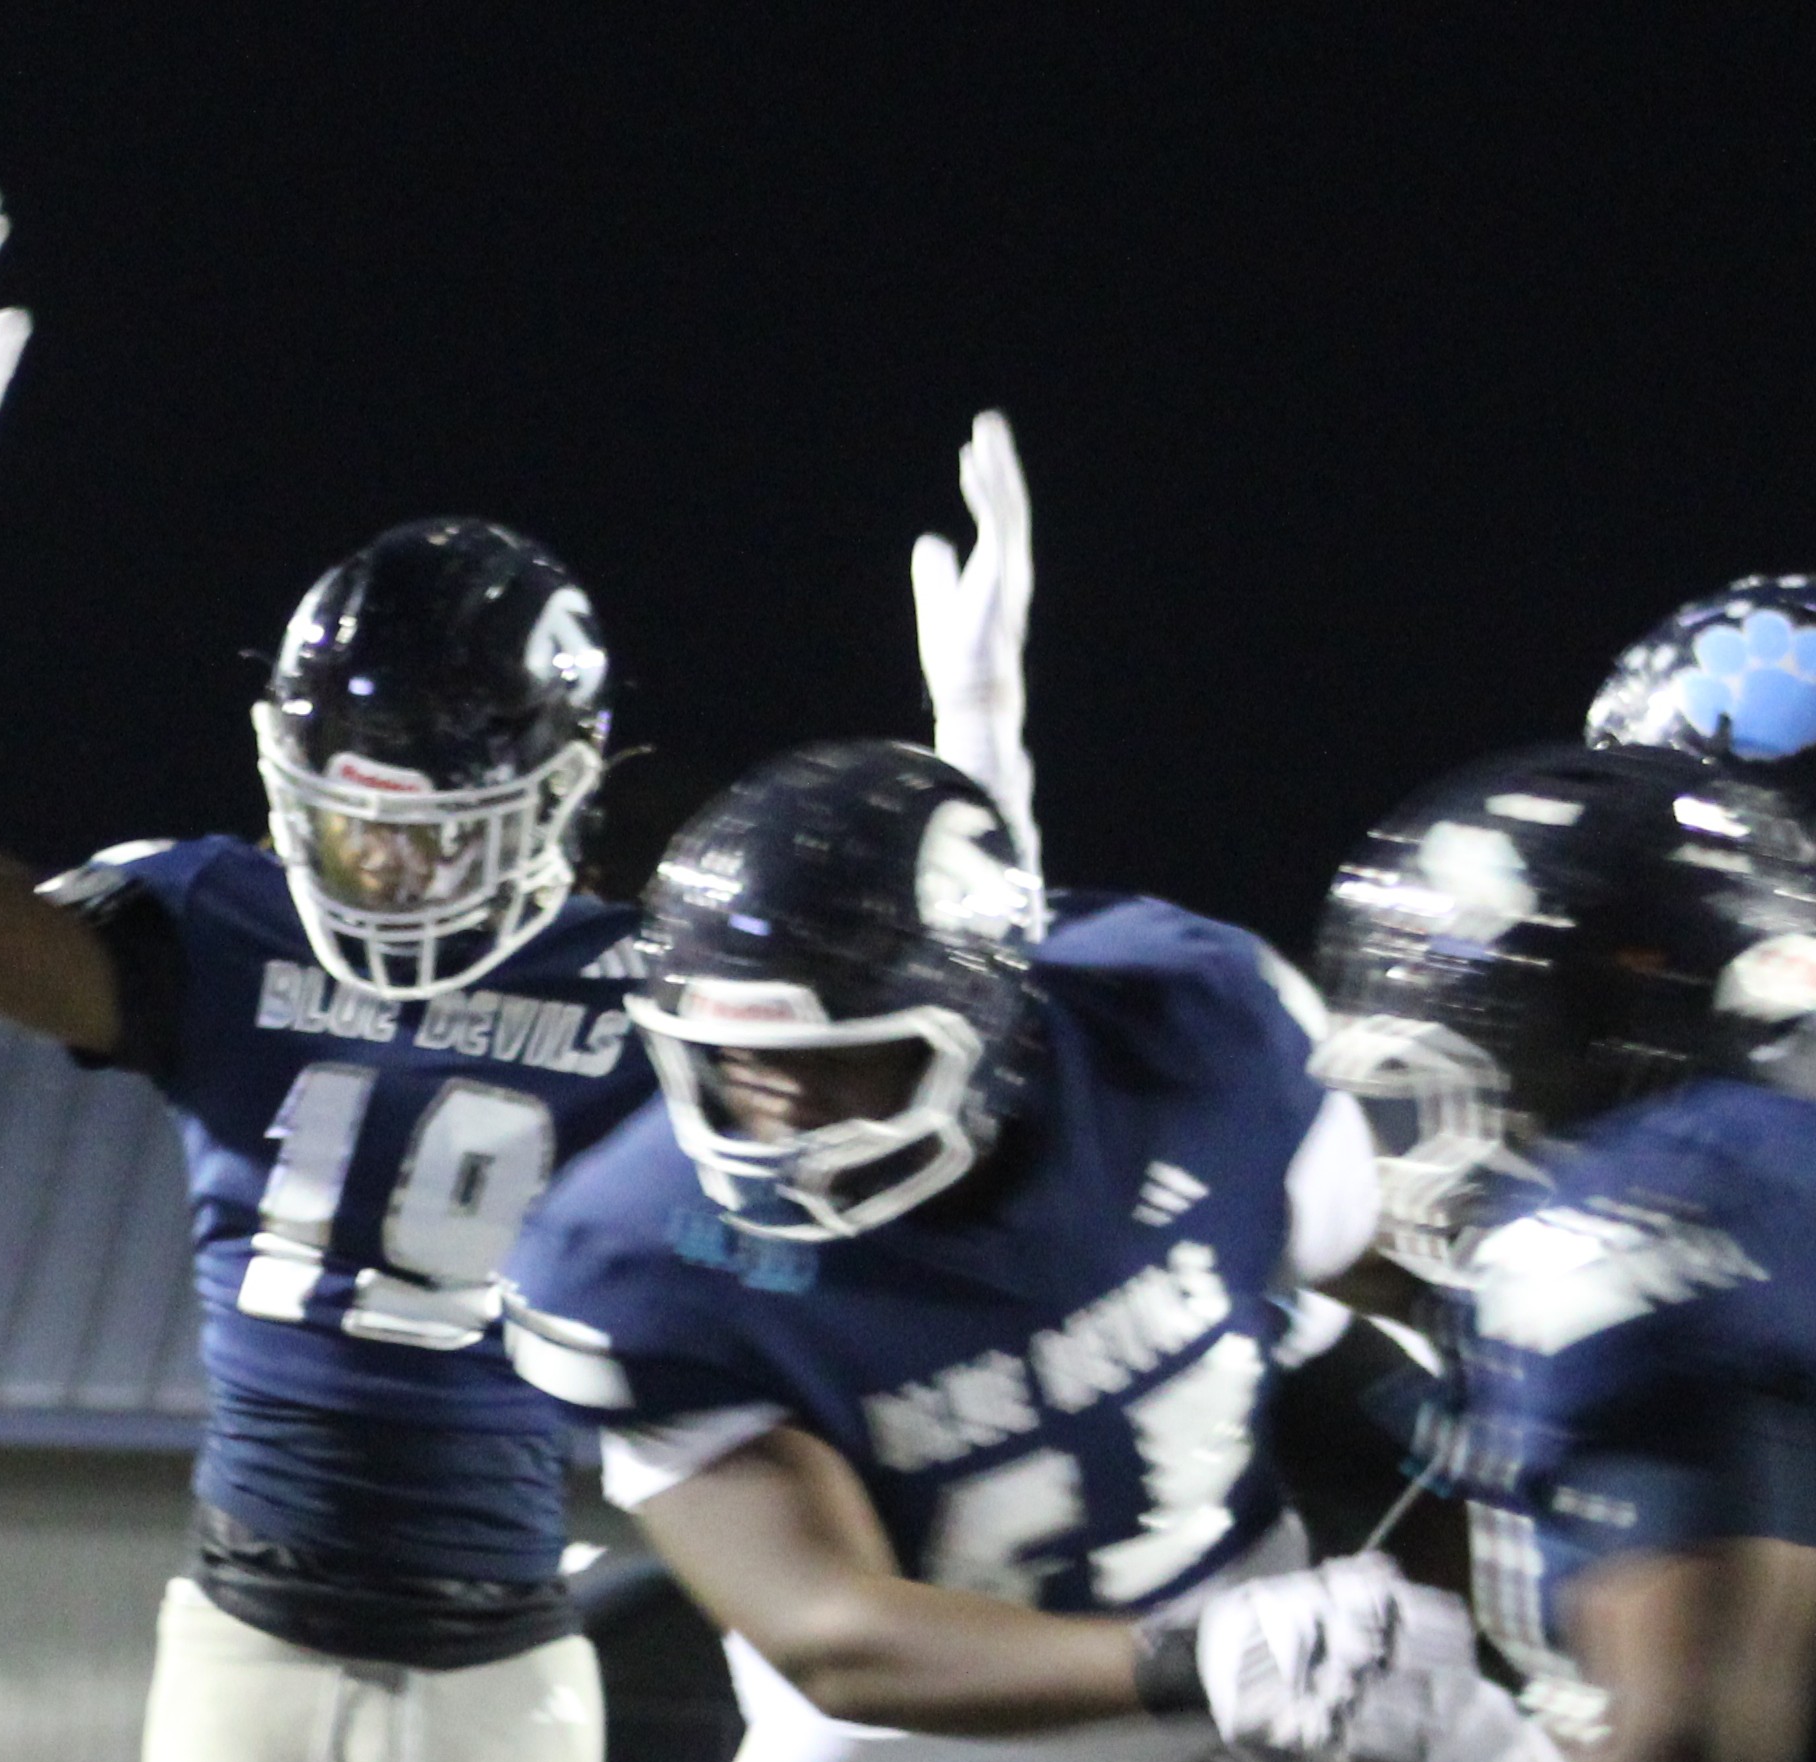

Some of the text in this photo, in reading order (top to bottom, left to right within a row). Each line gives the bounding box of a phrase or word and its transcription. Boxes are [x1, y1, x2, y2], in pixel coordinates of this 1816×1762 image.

[256, 959, 632, 1078] BLUE DEVILS
[237, 1060, 557, 1350] 19
